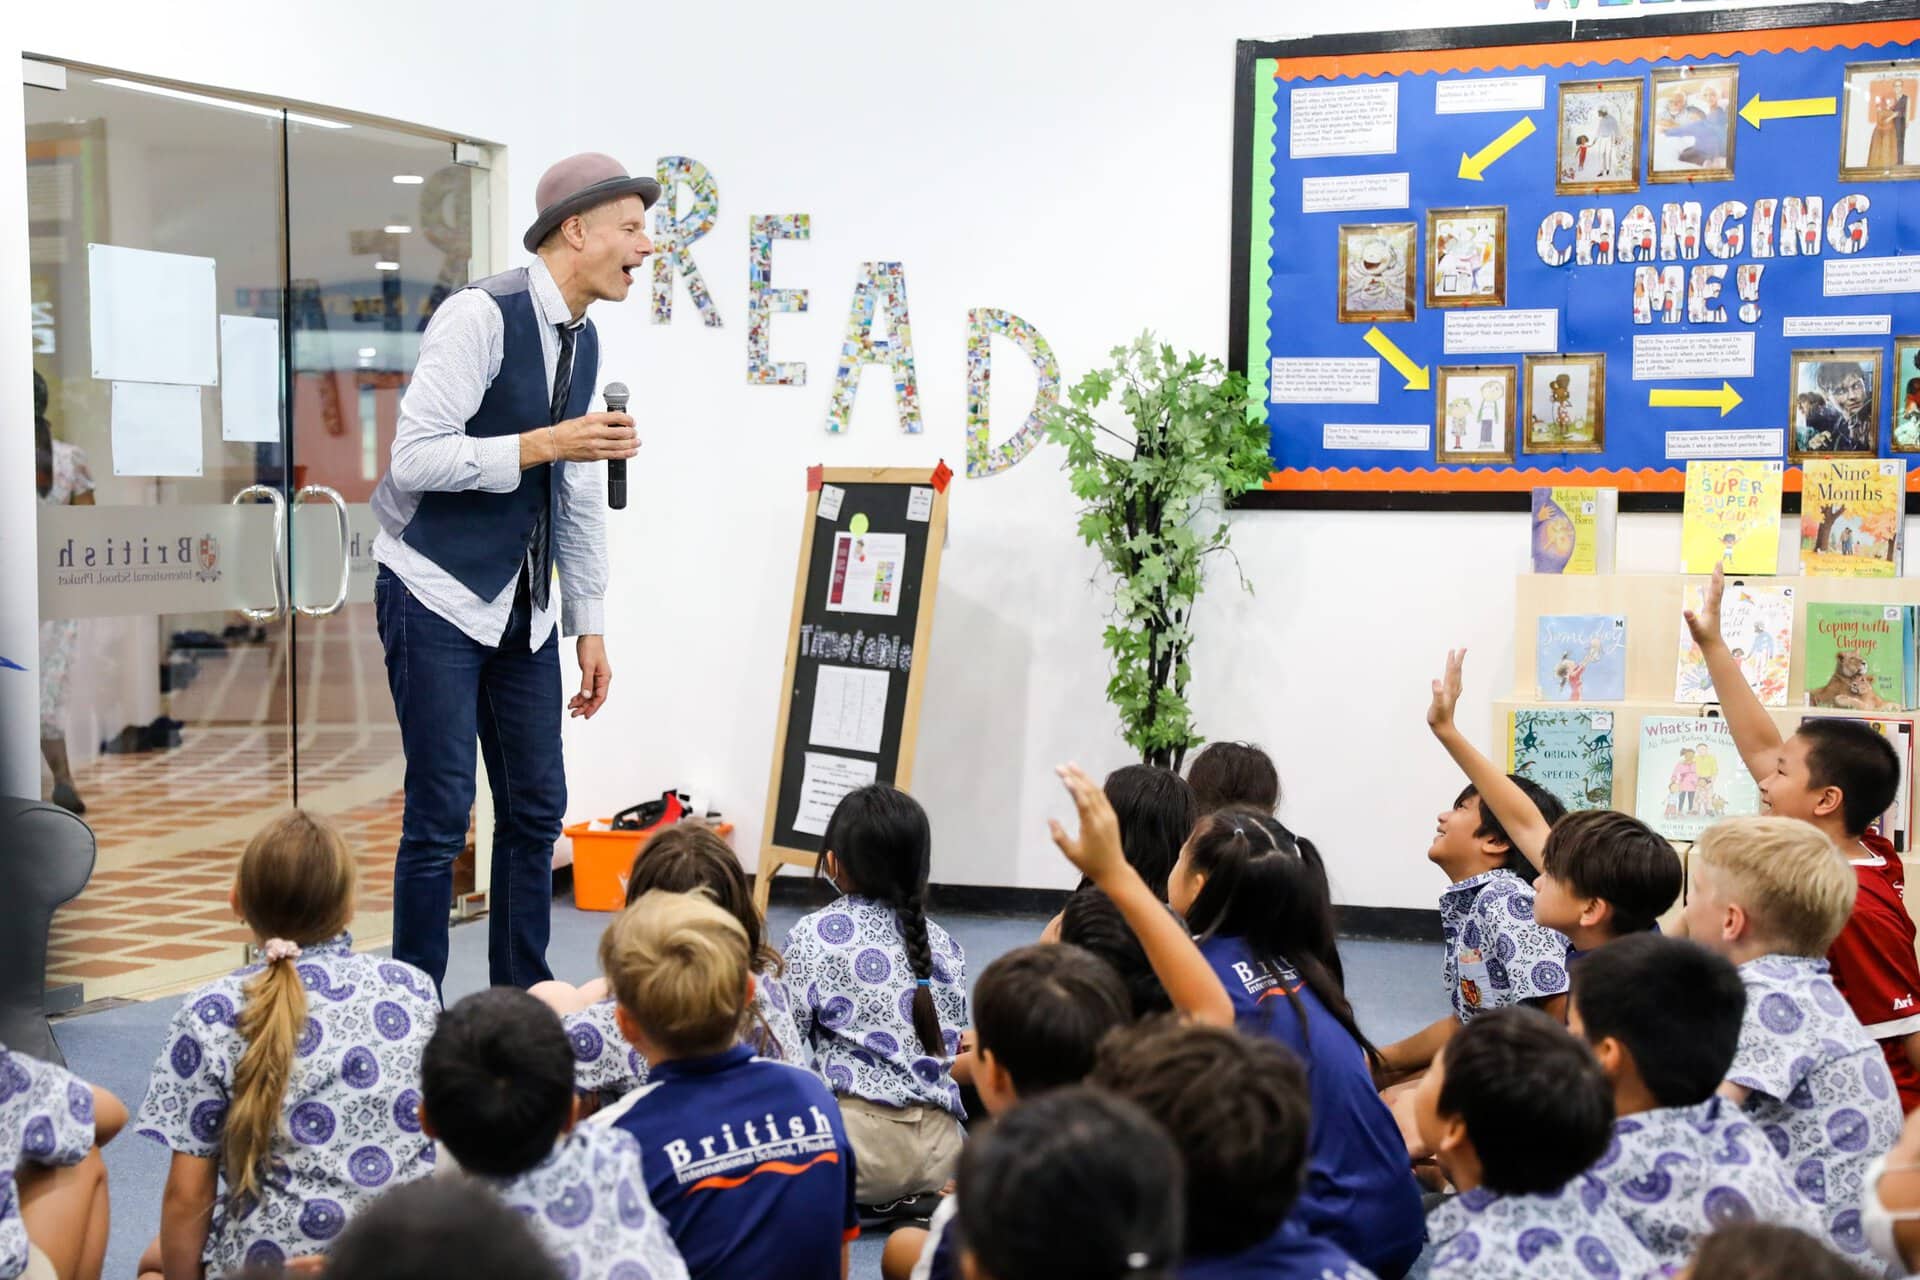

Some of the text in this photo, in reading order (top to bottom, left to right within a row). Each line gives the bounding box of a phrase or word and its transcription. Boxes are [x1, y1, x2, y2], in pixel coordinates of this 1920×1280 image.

[1536, 193, 1871, 267] CHANGING
[1632, 263, 1765, 325] ME!
[651, 155, 1062, 479] READ
[1831, 463, 1870, 481] Nine
[1702, 478, 1763, 495] SUPER
[1818, 483, 1883, 501] Months
[1574, 514, 1593, 525] Born
[1717, 511, 1746, 522] YOU
[1784, 588, 1792, 597] C
[1616, 620, 1623, 628] M
[1818, 620, 1889, 638] Coping with
[800, 624, 912, 673] Timetable
[1837, 634, 1877, 656] Change
[1646, 721, 1691, 737] What's
[1695, 721, 1708, 732] in
[1544, 750, 1578, 760] ORIGIN
[1542, 770, 1580, 780] SPECIES
[1893, 993, 1914, 1011] Ari
[663, 1105, 833, 1168] British
